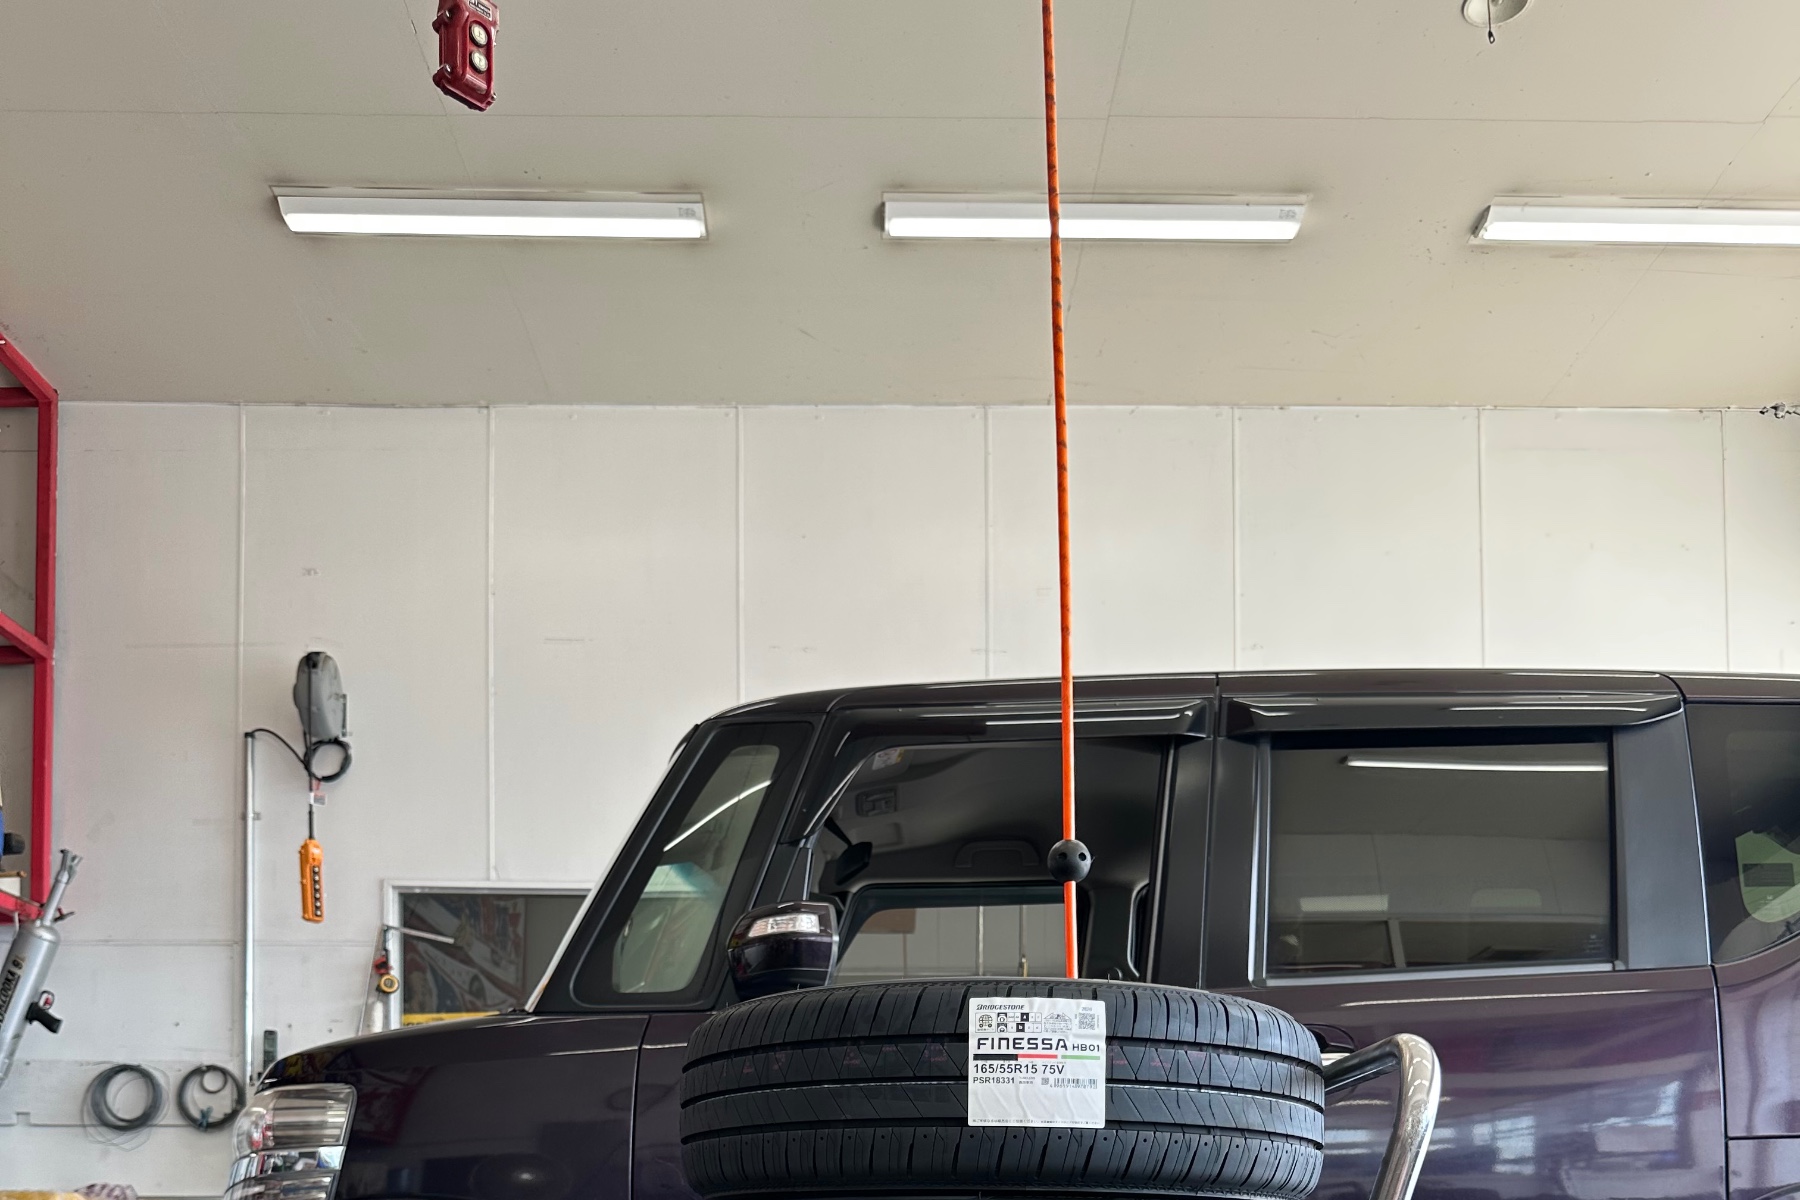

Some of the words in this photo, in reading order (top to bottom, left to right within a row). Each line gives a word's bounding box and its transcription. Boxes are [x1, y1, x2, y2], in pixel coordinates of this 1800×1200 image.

[0, 969, 17, 1023] AZOOKA
[977, 1037, 1068, 1051] FINESSA
[1072, 1043, 1100, 1052] HB01
[973, 1063, 1038, 1074] 165/55R15
[1041, 1064, 1065, 1075] 75V
